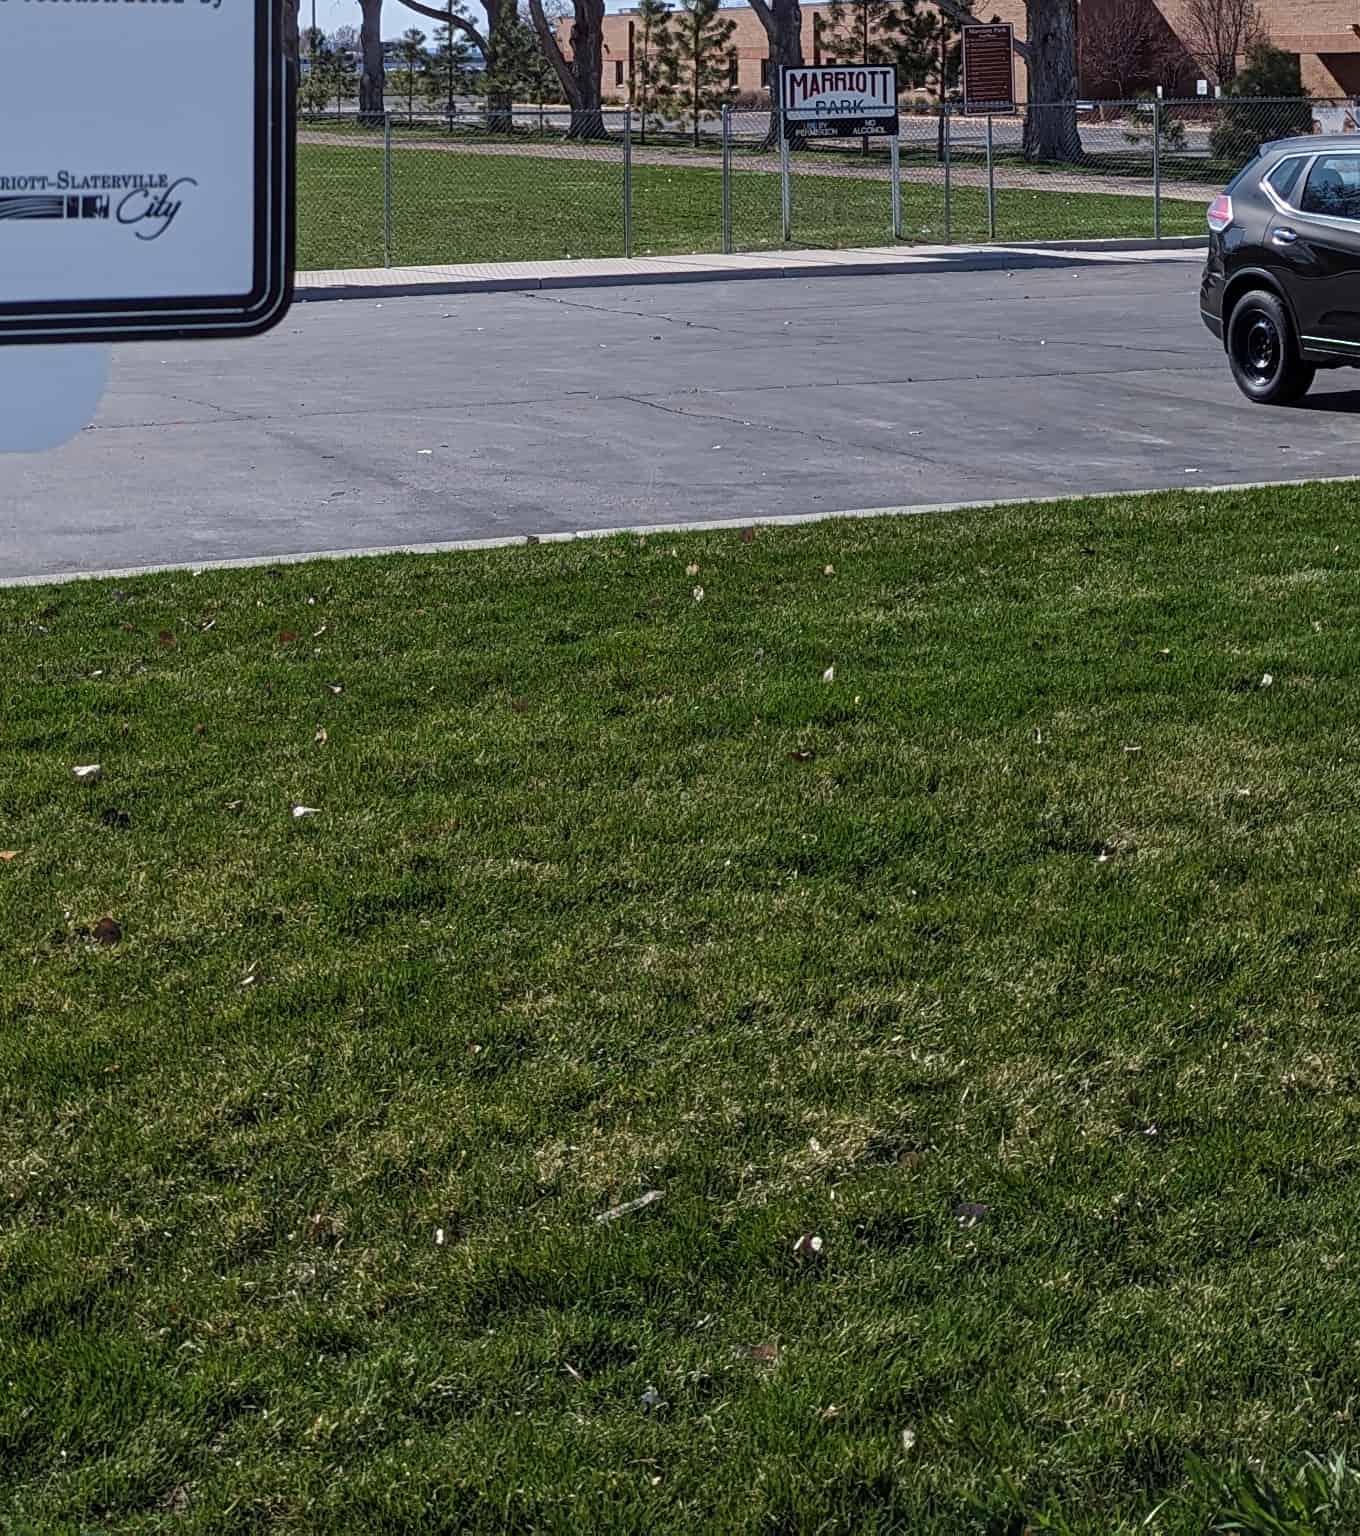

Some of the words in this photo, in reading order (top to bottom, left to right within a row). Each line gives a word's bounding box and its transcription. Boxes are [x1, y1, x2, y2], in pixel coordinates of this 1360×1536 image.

[790, 70, 891, 108] MARRIOTT
[816, 99, 864, 115] PARK
[116, 177, 199, 241] City
